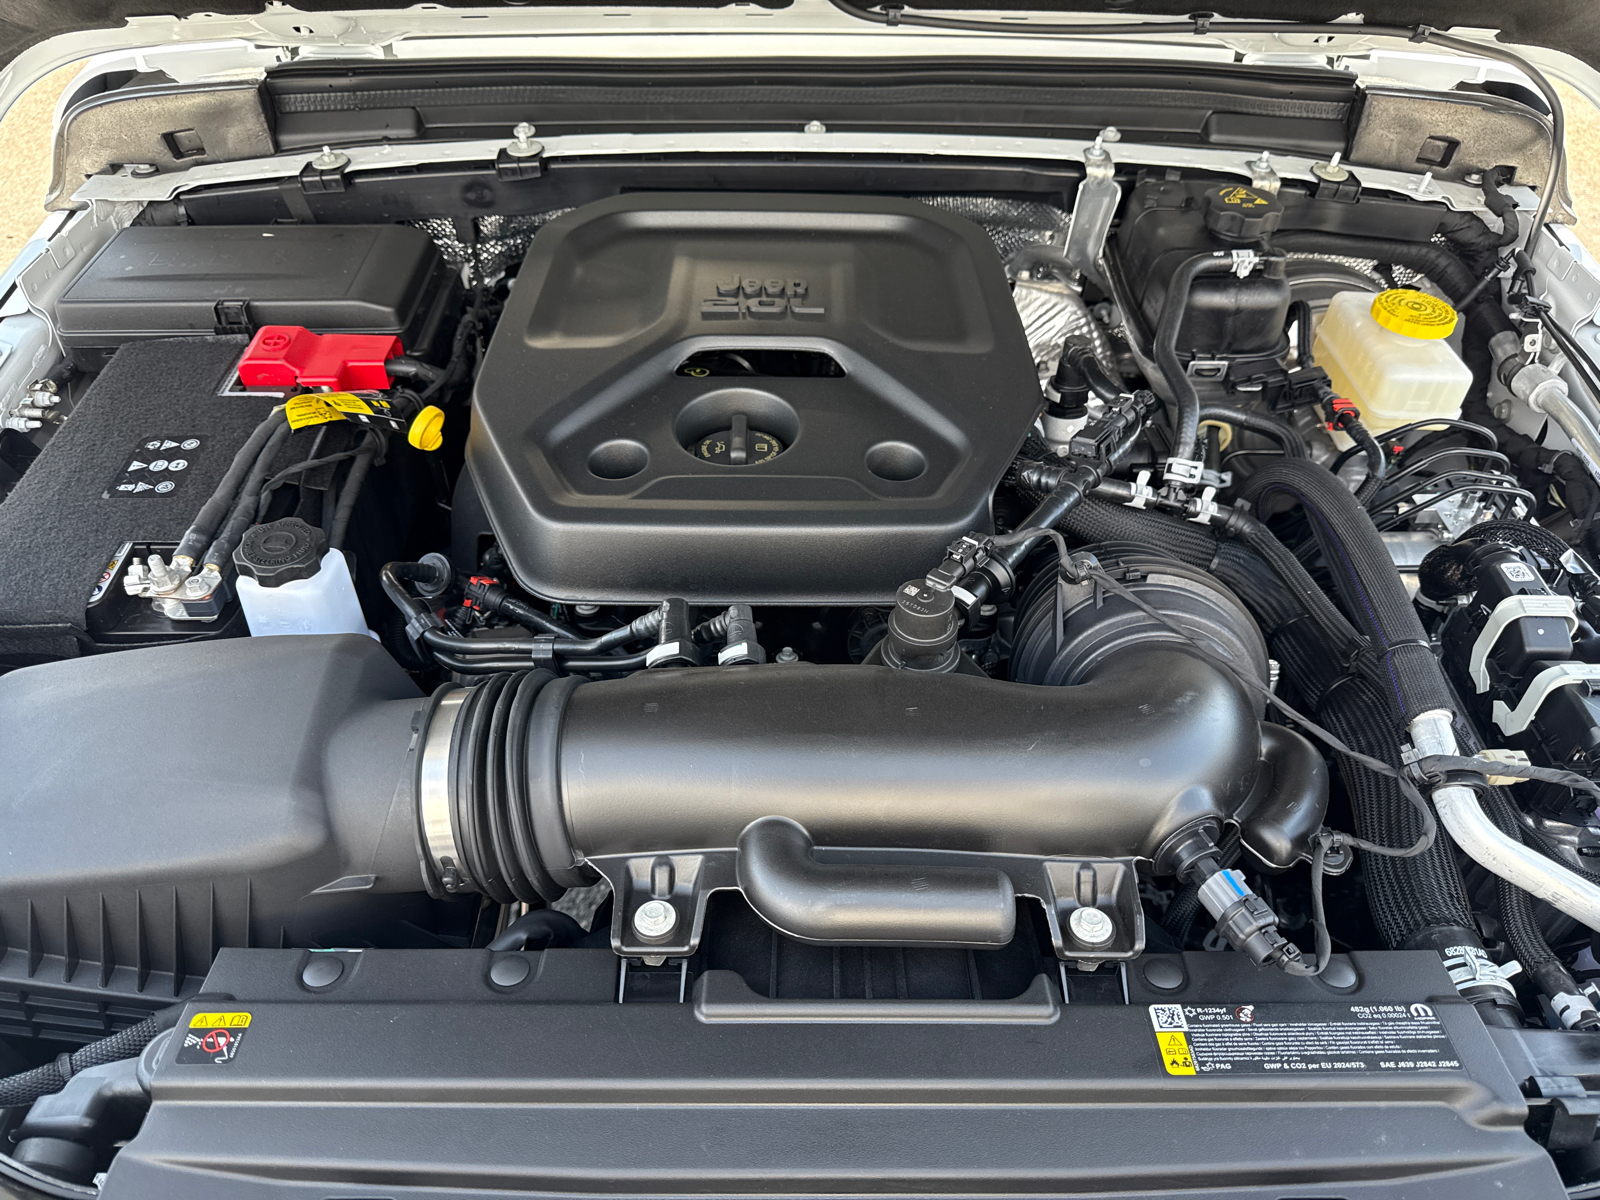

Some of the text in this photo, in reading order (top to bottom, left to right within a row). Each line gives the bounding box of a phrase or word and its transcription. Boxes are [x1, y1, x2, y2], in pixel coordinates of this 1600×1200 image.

[716, 274, 808, 297] Jeep
[701, 297, 825, 319] 2.0L
[1215, 1062, 1232, 1070] PAG
[1308, 1062, 1320, 1070] per
